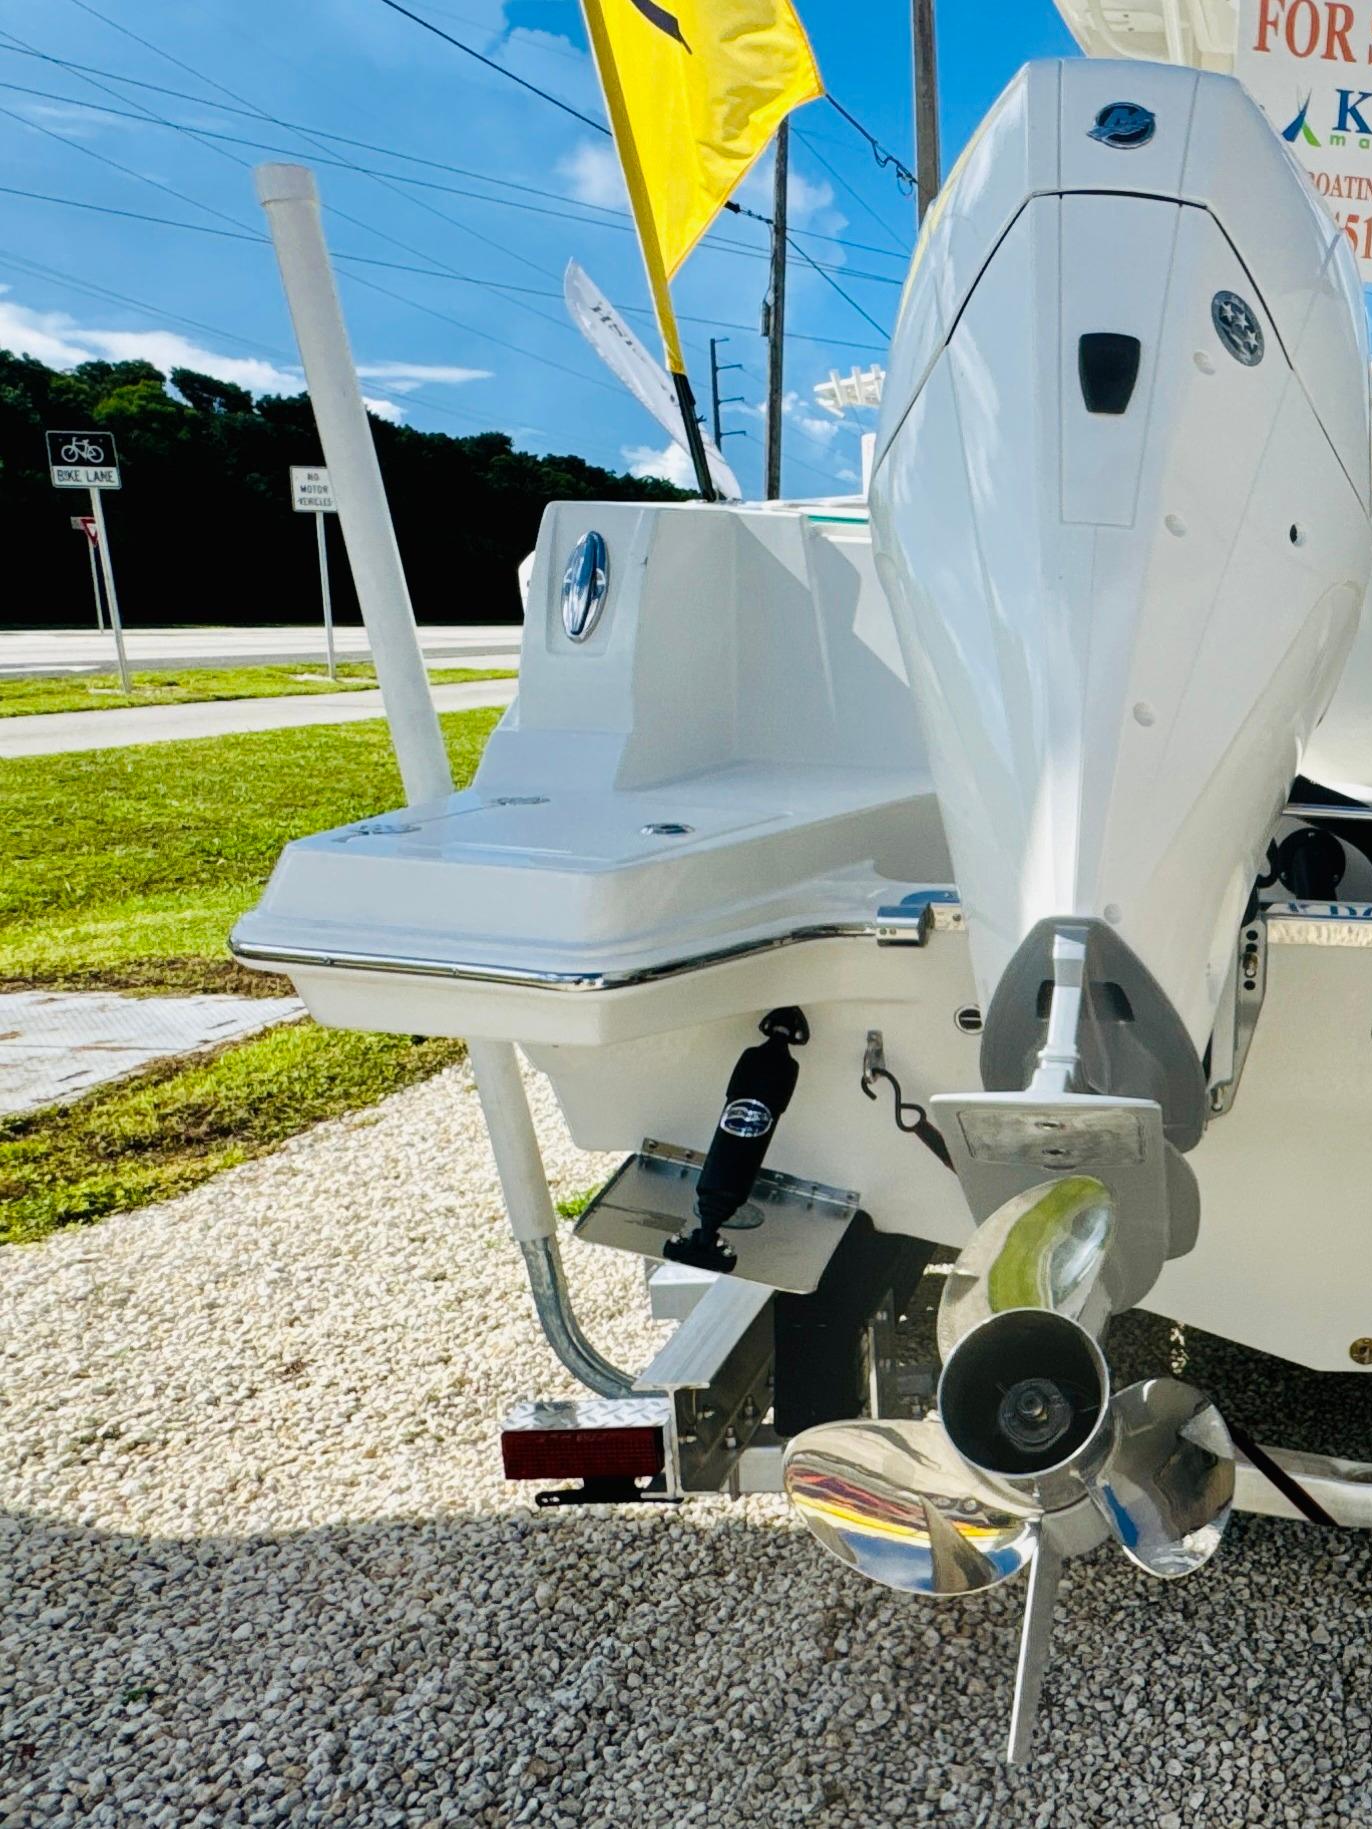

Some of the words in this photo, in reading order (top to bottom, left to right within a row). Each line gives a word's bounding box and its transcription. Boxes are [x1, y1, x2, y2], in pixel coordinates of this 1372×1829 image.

[1253, 0, 1356, 62] FOR
[57, 469, 80, 482] BIKE
[86, 470, 115, 483] LANE
[307, 472, 319, 481] NO
[300, 484, 328, 494] MOTOR
